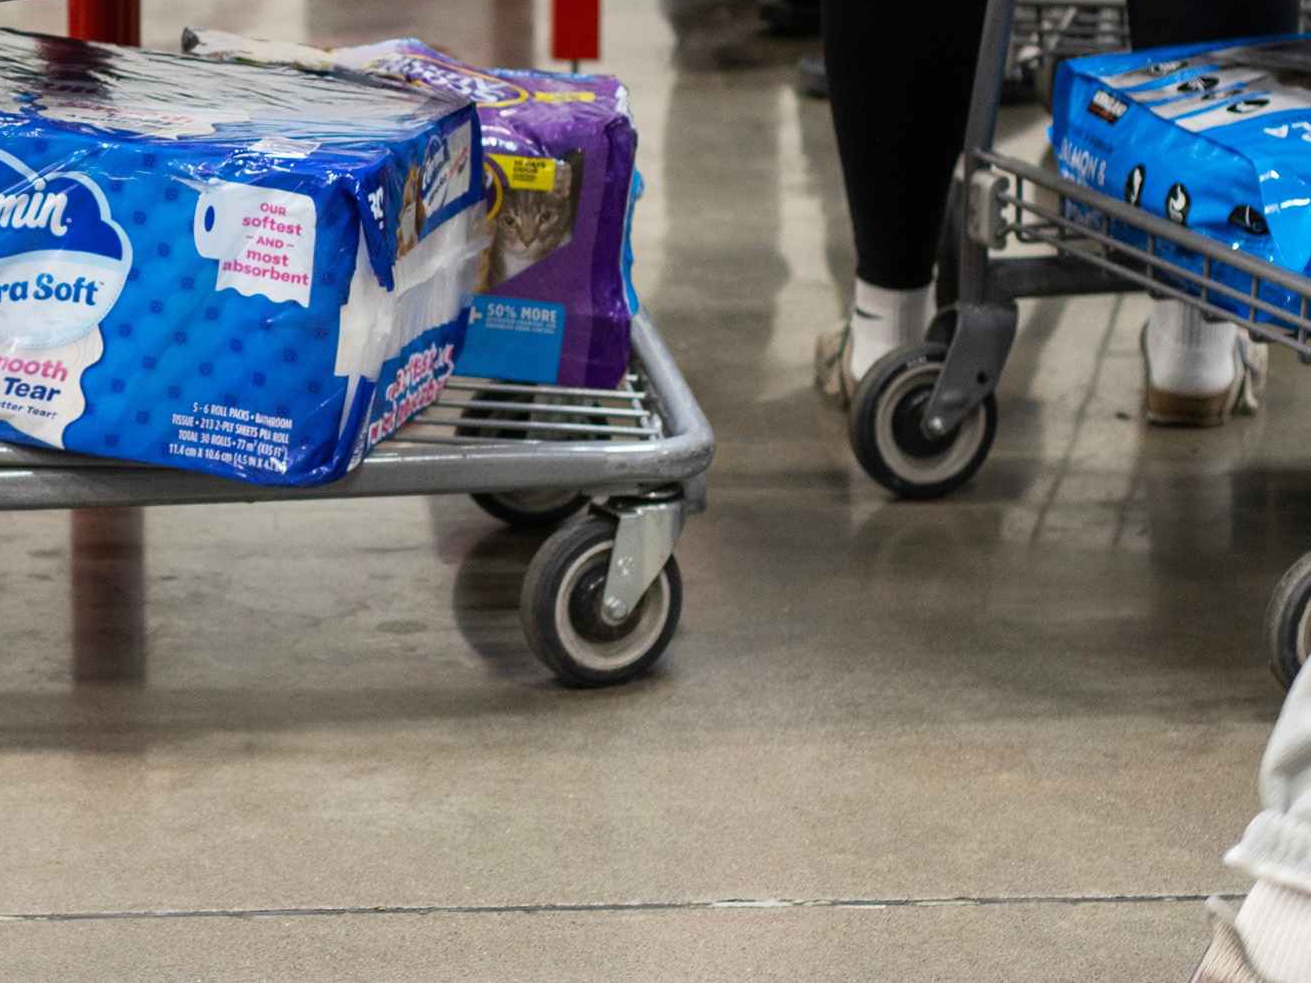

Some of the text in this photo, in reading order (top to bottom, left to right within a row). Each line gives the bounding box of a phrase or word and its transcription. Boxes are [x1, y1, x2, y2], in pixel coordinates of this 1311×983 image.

[260, 203, 287, 216] OUR
[242, 216, 303, 236] softest
[257, 236, 284, 249] AND
[246, 249, 289, 267] most
[222, 259, 309, 286] absorbent
[33, 273, 98, 305] Soft
[487, 303, 556, 322] 50% MORE
[4, 376, 61, 402] Tear
[211, 405, 227, 416] ROLL
[229, 407, 250, 420] PACKS
[211, 434, 231, 447] ROLLS
[273, 432, 289, 443] ROLL
